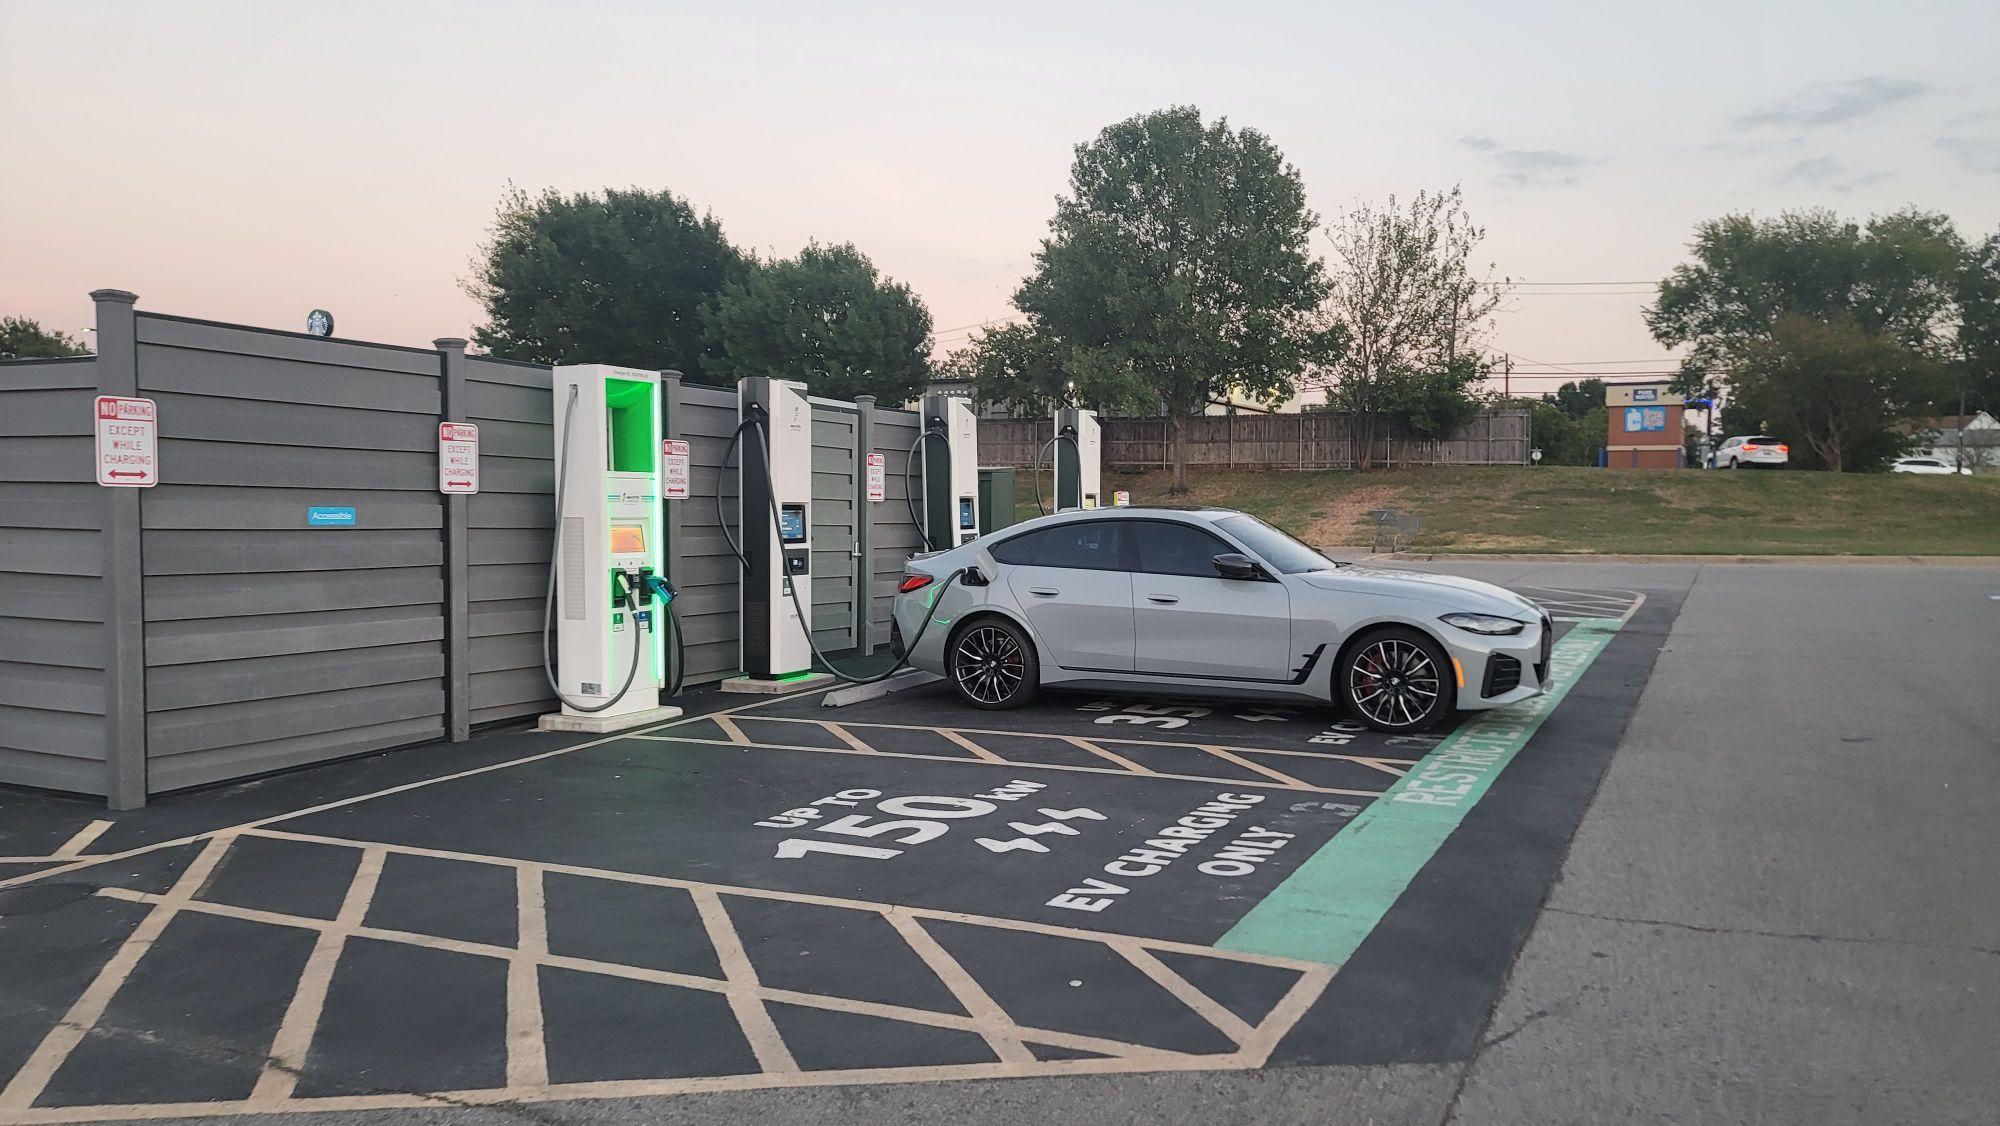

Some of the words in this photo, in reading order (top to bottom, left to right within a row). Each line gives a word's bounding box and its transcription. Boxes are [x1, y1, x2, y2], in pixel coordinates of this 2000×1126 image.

[100, 401, 117, 416] NO
[118, 404, 151, 416] PARKING
[109, 425, 145, 436] EXCEPT
[442, 426, 453, 438] NO
[453, 428, 475, 438] PARKING
[113, 440, 142, 450] WHILE
[104, 454, 151, 465] CHARGING
[450, 457, 469, 465] WHILE
[445, 468, 474, 477] CHARGING
[666, 477, 688, 485] CHARGING
[312, 511, 352, 520] Accessible
[1307, 731, 1356, 745] EV
[1392, 722, 1526, 807] RESTRICTED
[753, 807, 823, 829] UP
[809, 788, 882, 807] TO
[773, 795, 998, 860] 150
[1045, 877, 1131, 912] EV
[1104, 792, 1266, 876] CHARGING
[1197, 825, 1296, 876] ONLY
